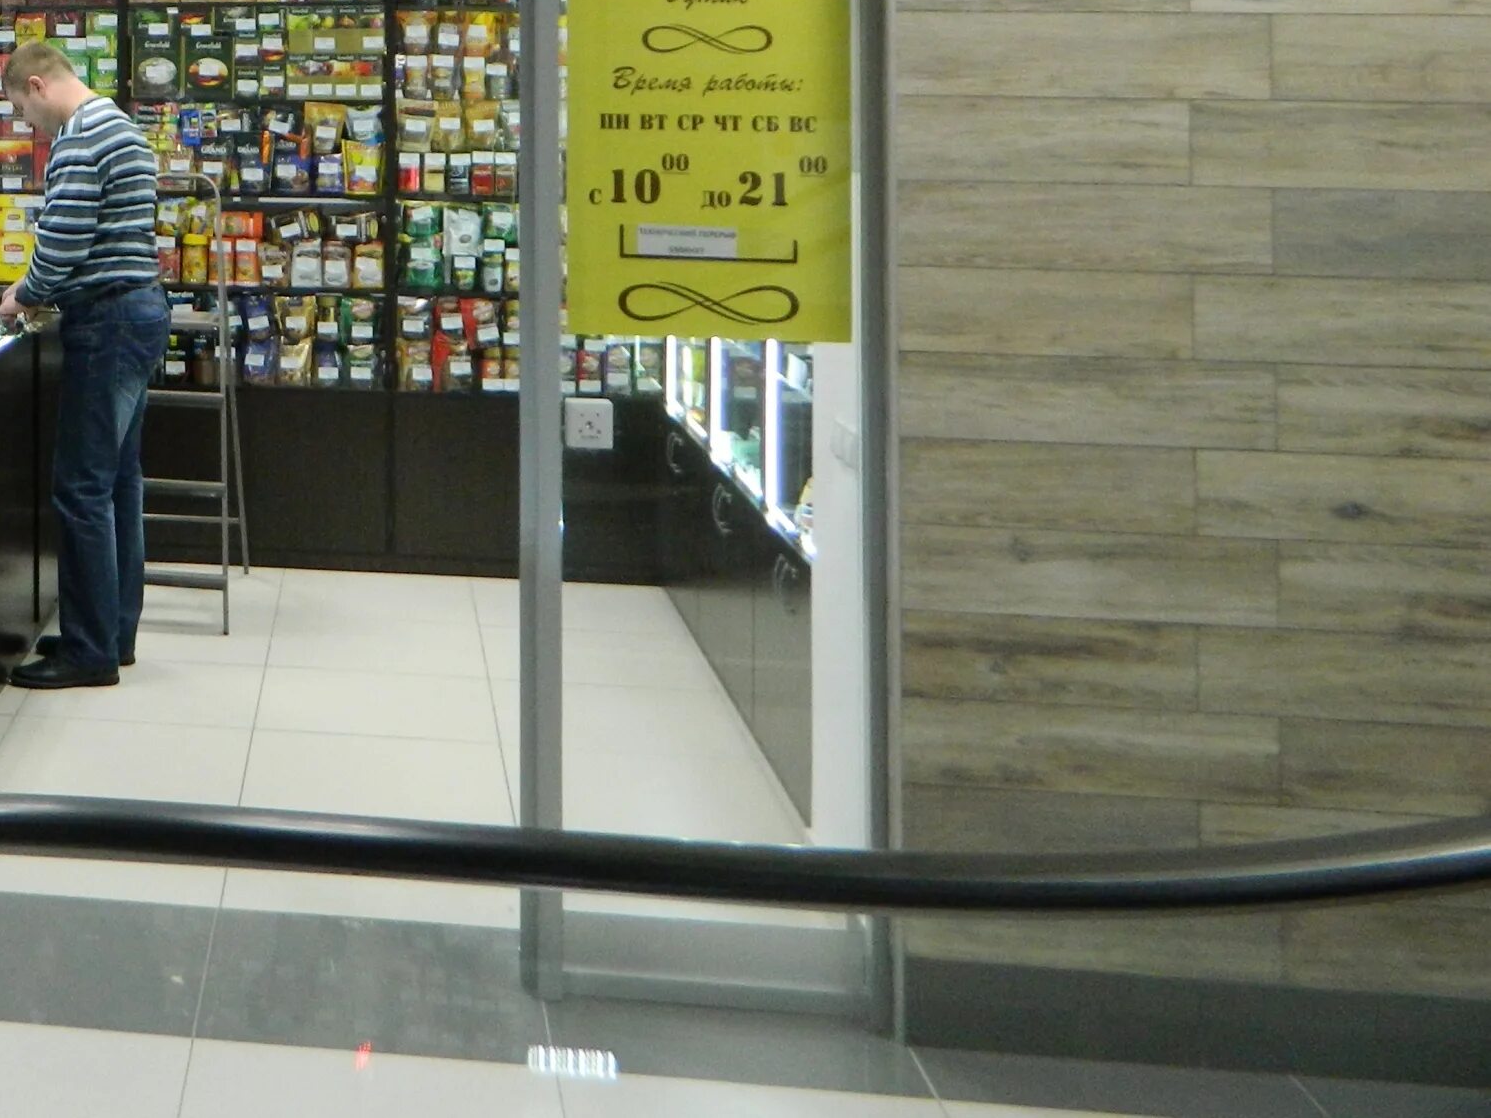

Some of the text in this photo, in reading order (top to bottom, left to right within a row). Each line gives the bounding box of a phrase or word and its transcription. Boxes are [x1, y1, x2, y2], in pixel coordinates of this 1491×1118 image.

[611, 66, 804, 97] Время работы:
[599, 113, 817, 132] ПН ВТ СР ЧТ СБ ВС
[611, 169, 661, 204] 10
[701, 190, 732, 209] до
[738, 171, 789, 207] 21
